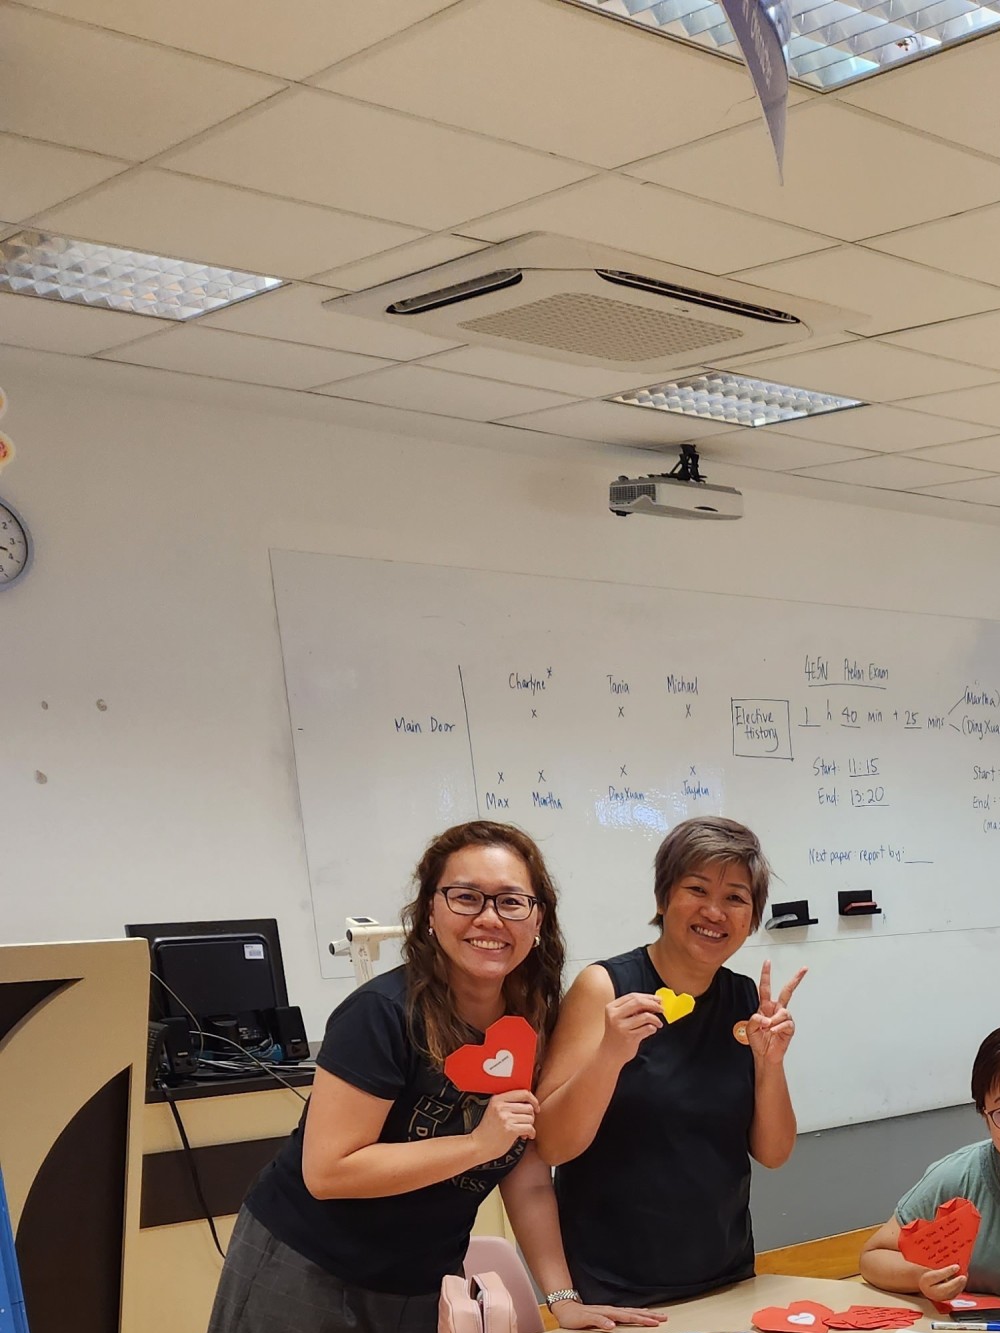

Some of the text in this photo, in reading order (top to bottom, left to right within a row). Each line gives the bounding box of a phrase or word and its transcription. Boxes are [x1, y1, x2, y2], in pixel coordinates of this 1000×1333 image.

[868, 663, 889, 680] Exam
[607, 674, 630, 694] Tania
[667, 674, 699, 695] Michael
[394, 716, 456, 733] Main Door
[735, 706, 775, 726] Elective
[826, 699, 832, 720] h
[841, 707, 857, 722] 40
[868, 710, 883, 722] min
[905, 711, 918, 725] 25
[927, 717, 945, 730] mins
[744, 725, 779, 753] History
[486, 792, 509, 810] Max
[809, 848, 827, 865] Next
[859, 844, 884, 865] report
[424, 1101, 444, 1115] 17
